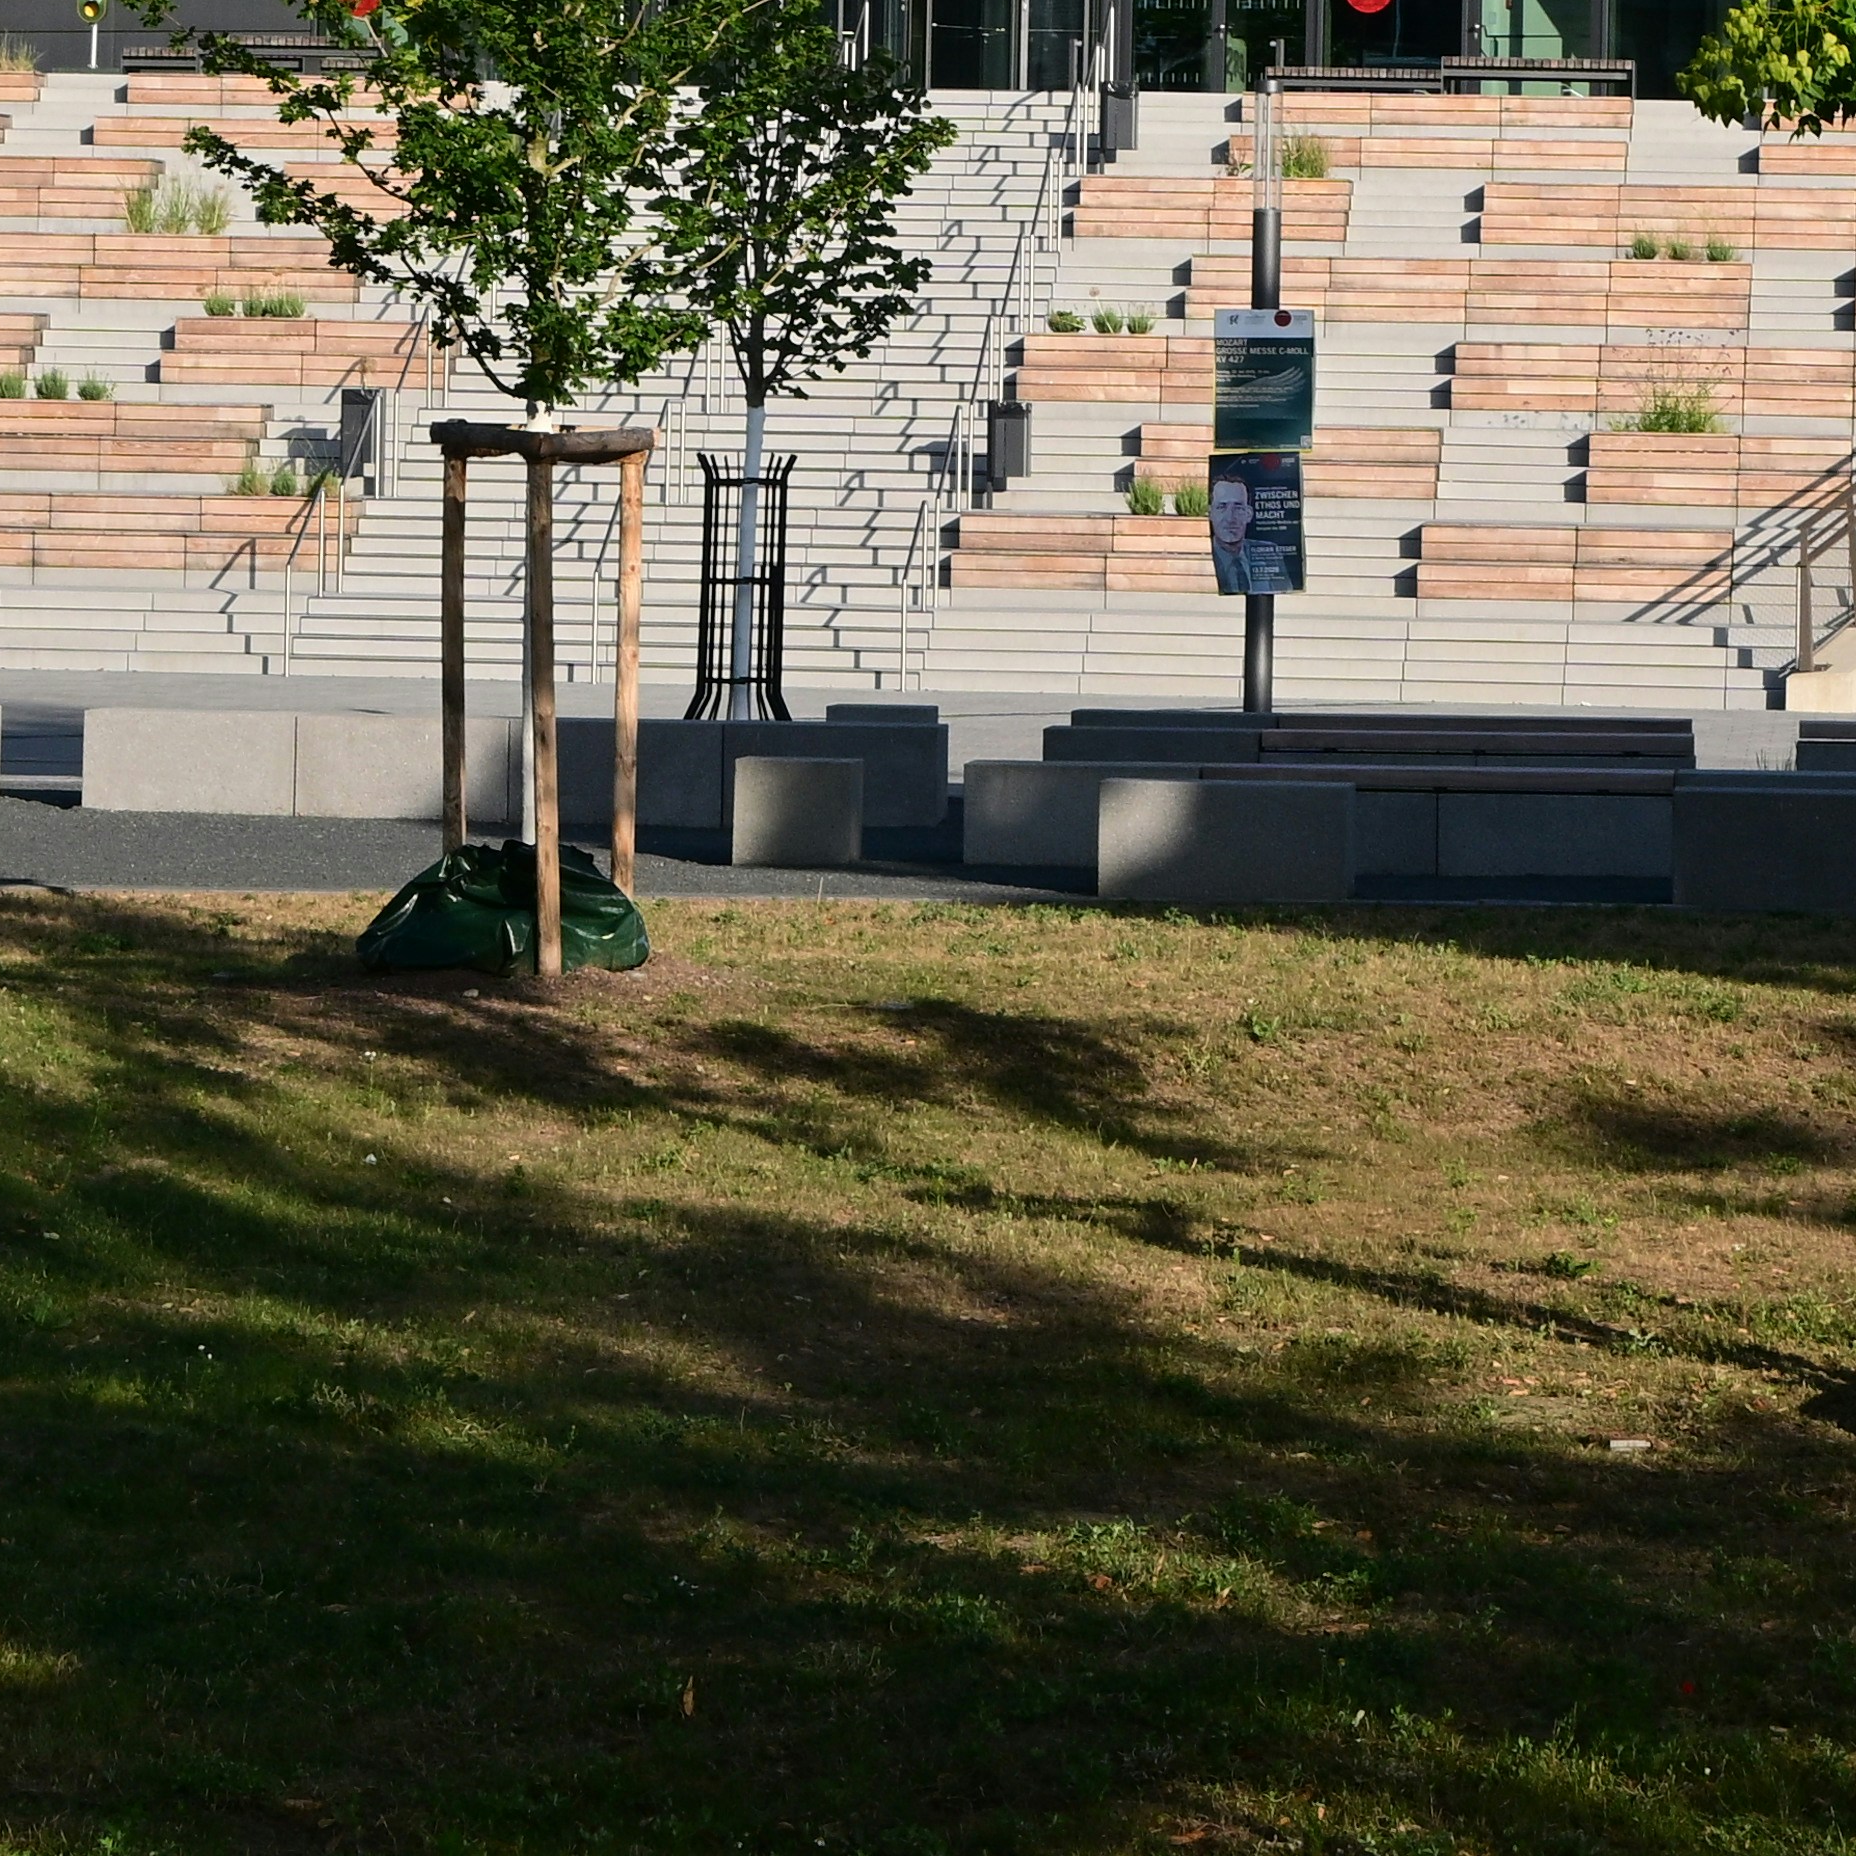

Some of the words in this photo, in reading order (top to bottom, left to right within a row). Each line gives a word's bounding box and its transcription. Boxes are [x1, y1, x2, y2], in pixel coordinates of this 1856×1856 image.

[1249, 347, 1277, 355] MESSE
[1255, 490, 1298, 500] ZWISCHEN
[1255, 500, 1281, 510] ETHOS
[1283, 499, 1301, 509] UND
[1256, 510, 1285, 519] MACHT
